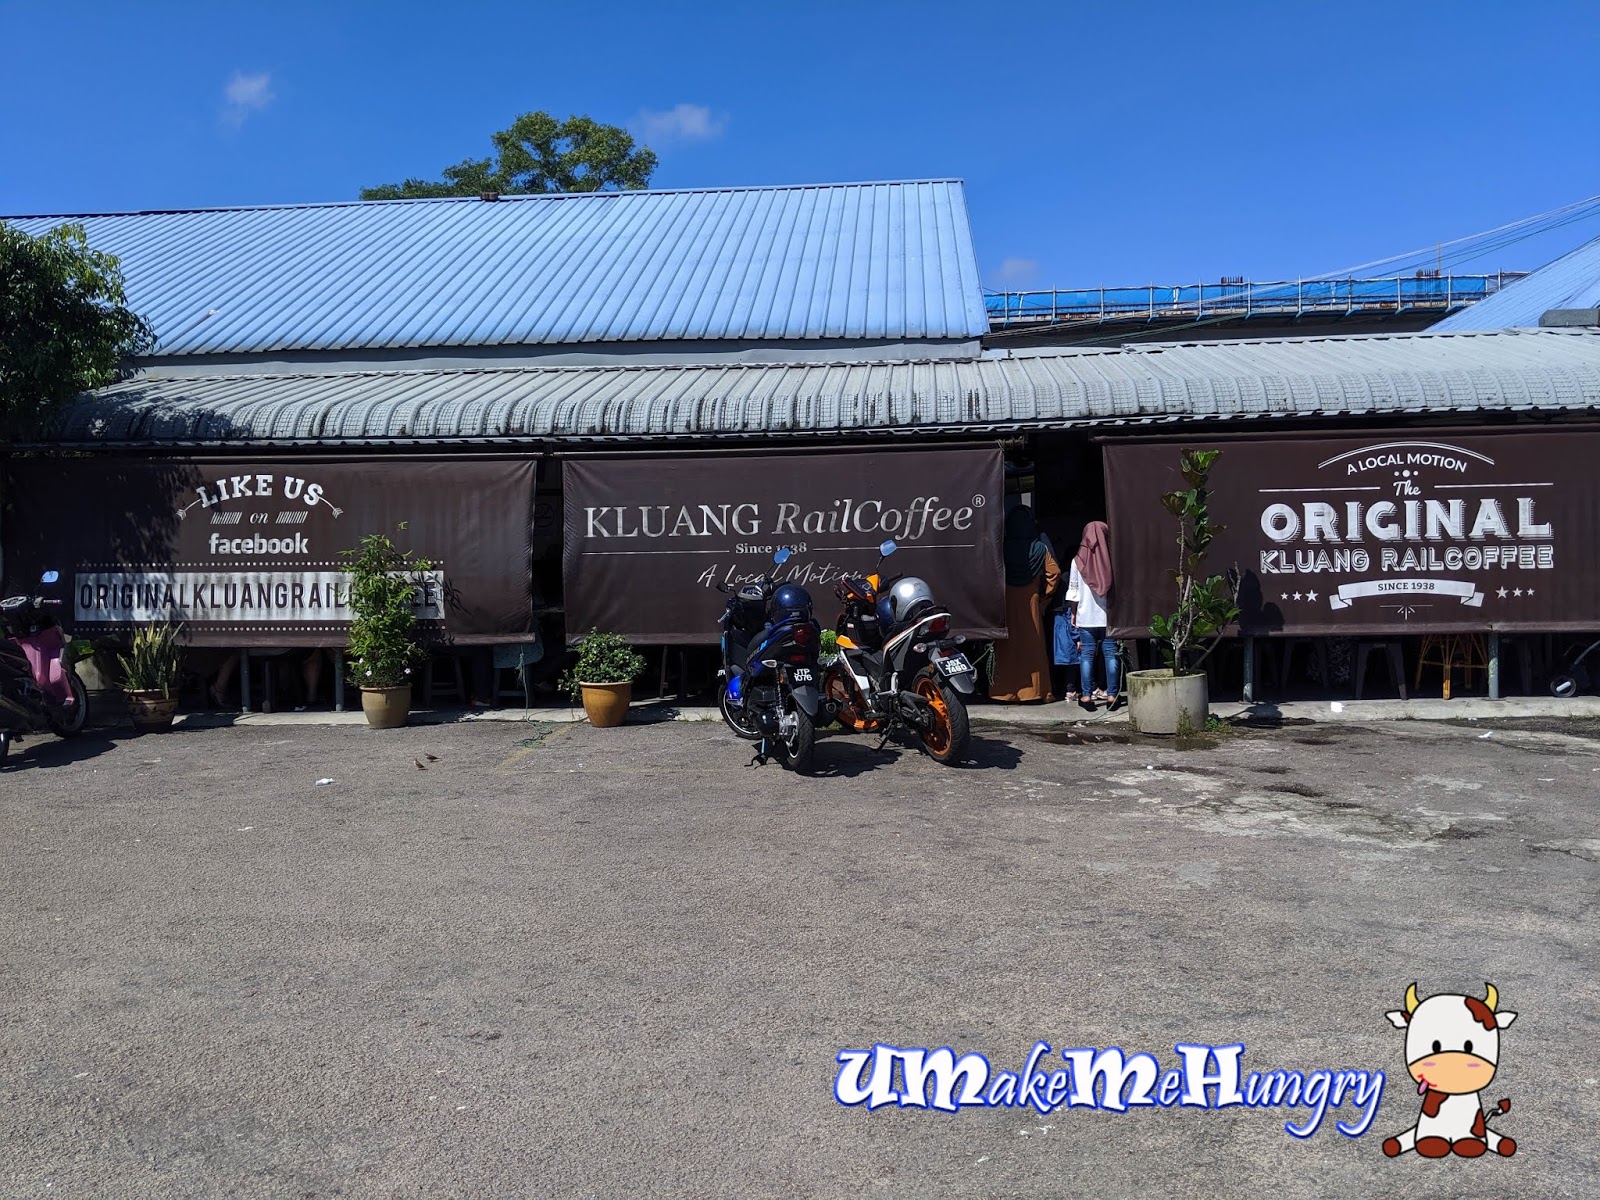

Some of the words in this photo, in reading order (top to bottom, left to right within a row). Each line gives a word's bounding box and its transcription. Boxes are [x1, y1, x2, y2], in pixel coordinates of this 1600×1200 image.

[1347, 463, 1358, 476] A
[1358, 453, 1404, 472] LOCAL
[1407, 453, 1467, 473] MOTION
[196, 474, 274, 508] LIKE
[284, 475, 324, 506] US
[1393, 480, 1421, 496] The
[250, 512, 269, 524] on
[583, 503, 762, 538] KLUANG
[1260, 498, 1554, 545] ORIGINAL
[208, 532, 309, 555] facebook
[735, 543, 772, 554] Since
[776, 542, 807, 555] 138
[1259, 549, 1370, 574] KLUANG
[1381, 545, 1554, 571] RAILCOFFEE
[697, 564, 718, 587] A
[786, 561, 866, 586] Motion
[1377, 582, 1408, 592] SINCE
[1411, 582, 1435, 591] 1938
